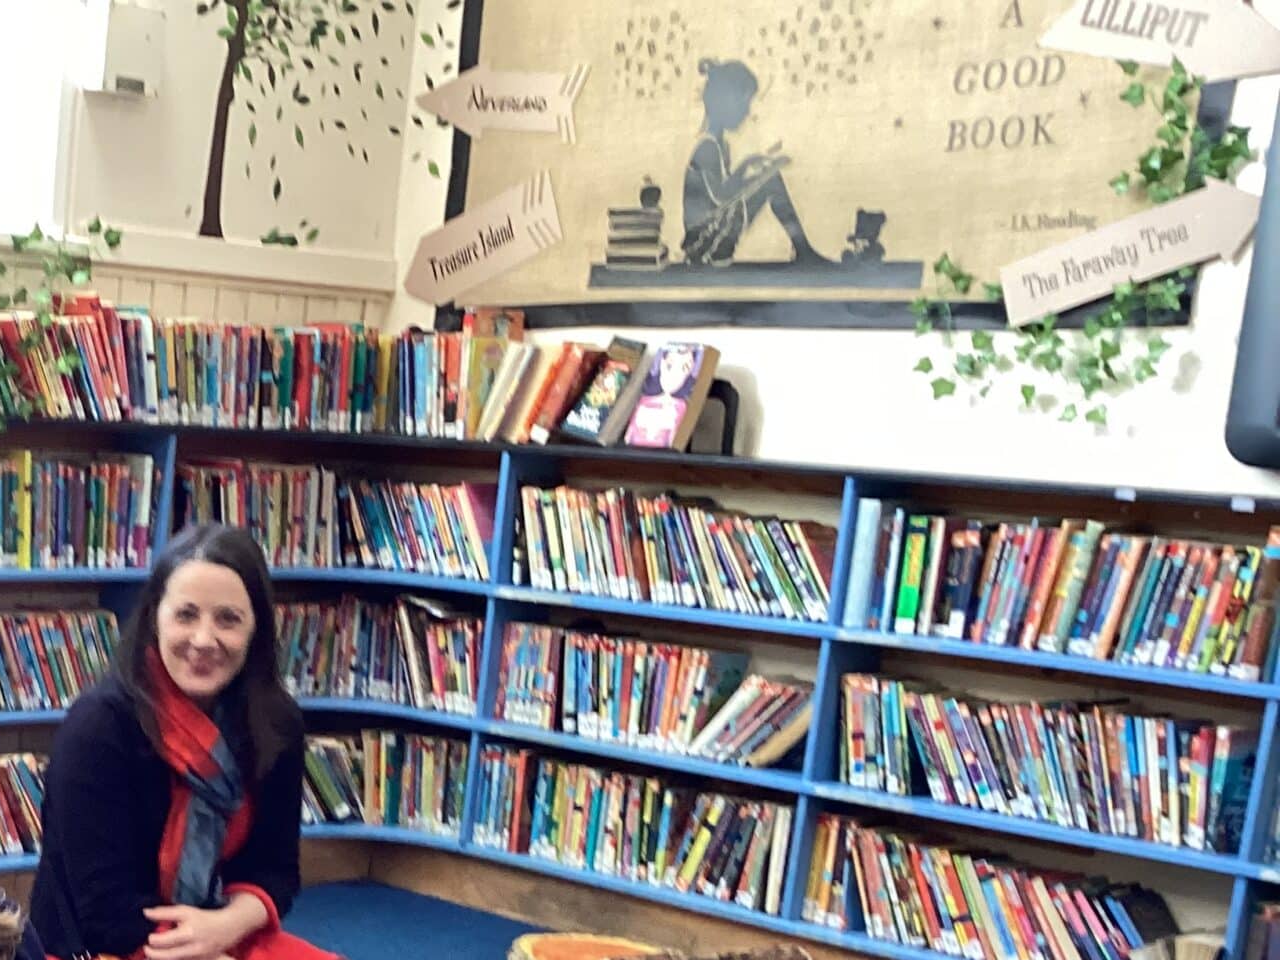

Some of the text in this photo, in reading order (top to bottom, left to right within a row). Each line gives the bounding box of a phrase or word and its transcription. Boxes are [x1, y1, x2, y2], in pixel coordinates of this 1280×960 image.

[1001, 0, 1024, 27] A
[1081, 0, 1209, 47] LILLIPUT
[952, 55, 1067, 95] GOOD
[946, 113, 1056, 151] BOOK
[429, 214, 515, 283] Treasure Island
[1022, 222, 1190, 299] The Faraway Tree
